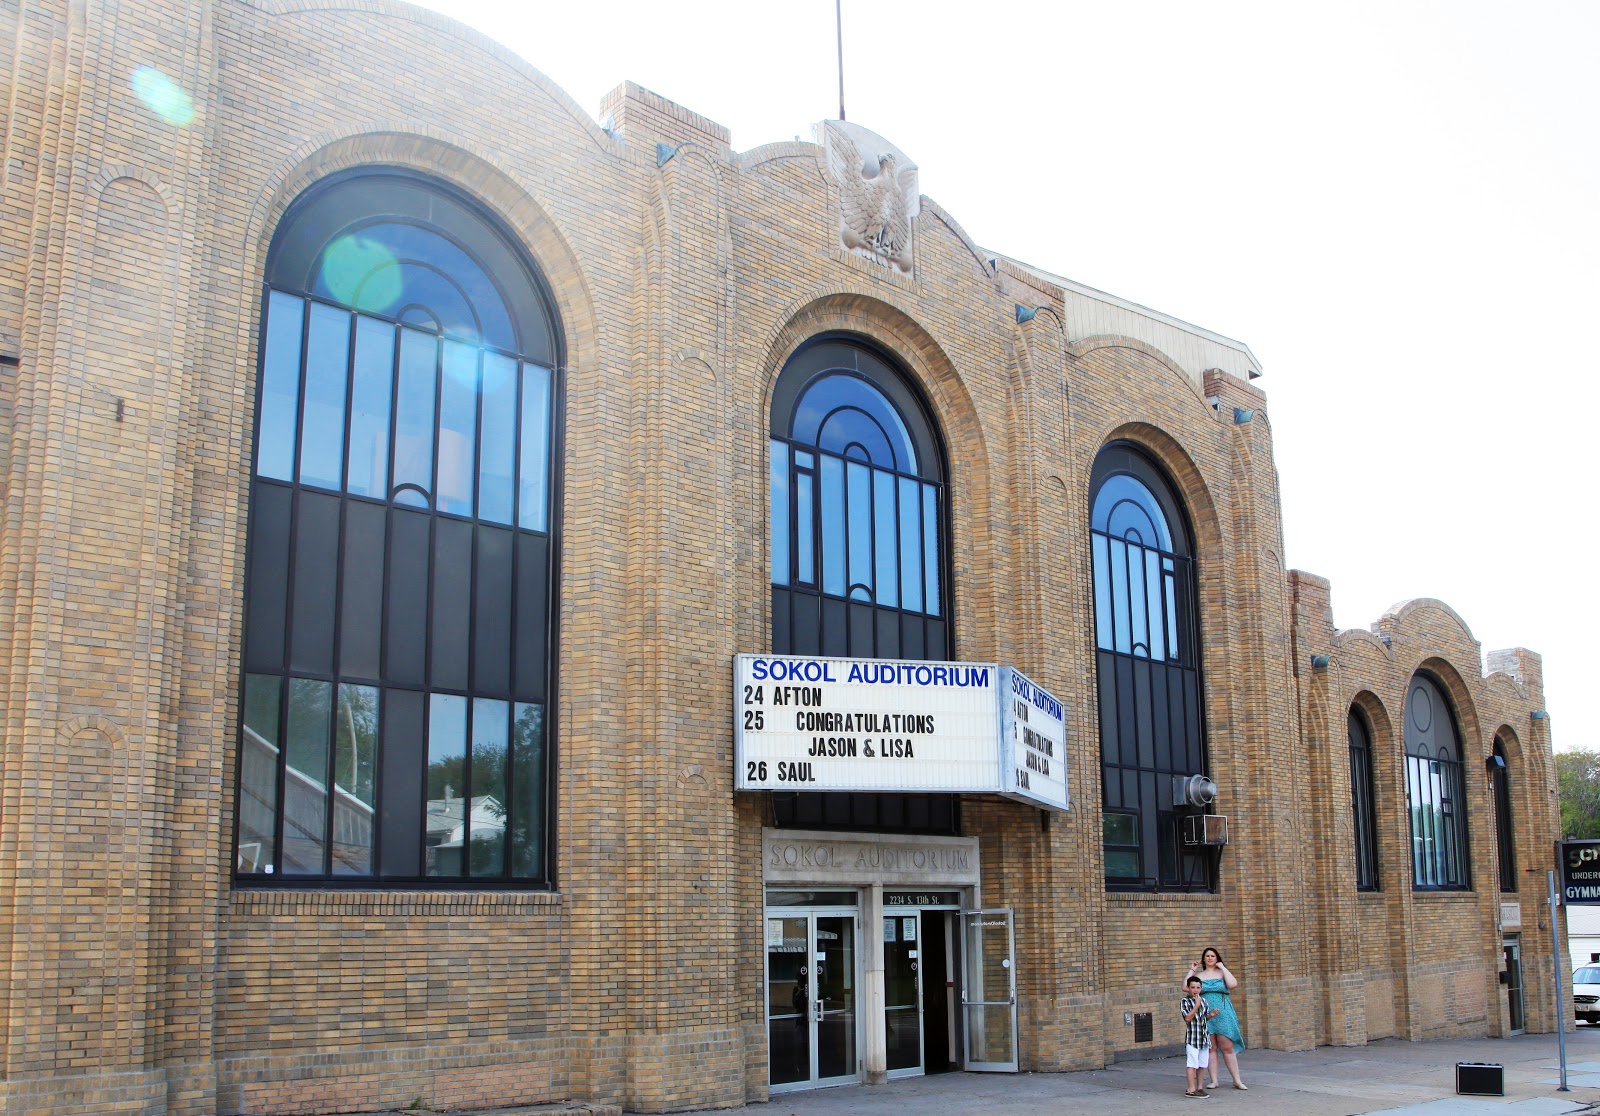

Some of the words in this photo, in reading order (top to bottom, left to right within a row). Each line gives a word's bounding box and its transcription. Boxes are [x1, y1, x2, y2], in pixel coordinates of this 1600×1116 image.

[752, 660, 836, 683] SOKOL
[848, 664, 989, 687] AUDITORIUM
[744, 685, 764, 705] 24
[773, 686, 821, 707] AFTON
[1012, 674, 1031, 702] SOKOL
[1033, 688, 1062, 721] AUDITORIUM
[744, 711, 764, 730] 25
[796, 712, 935, 734] CONGRATULATIONS
[808, 737, 857, 757] JASON
[863, 738, 875, 757] &
[881, 739, 914, 758] LISA
[747, 761, 767, 781] 26
[777, 762, 815, 782] SAUL
[770, 845, 842, 868] SOKOL
[854, 847, 970, 870] AUDITORIUM
[1571, 871, 1600, 880] UNDER
[889, 895, 904, 905] 2234
[916, 895, 929, 905] 13th
